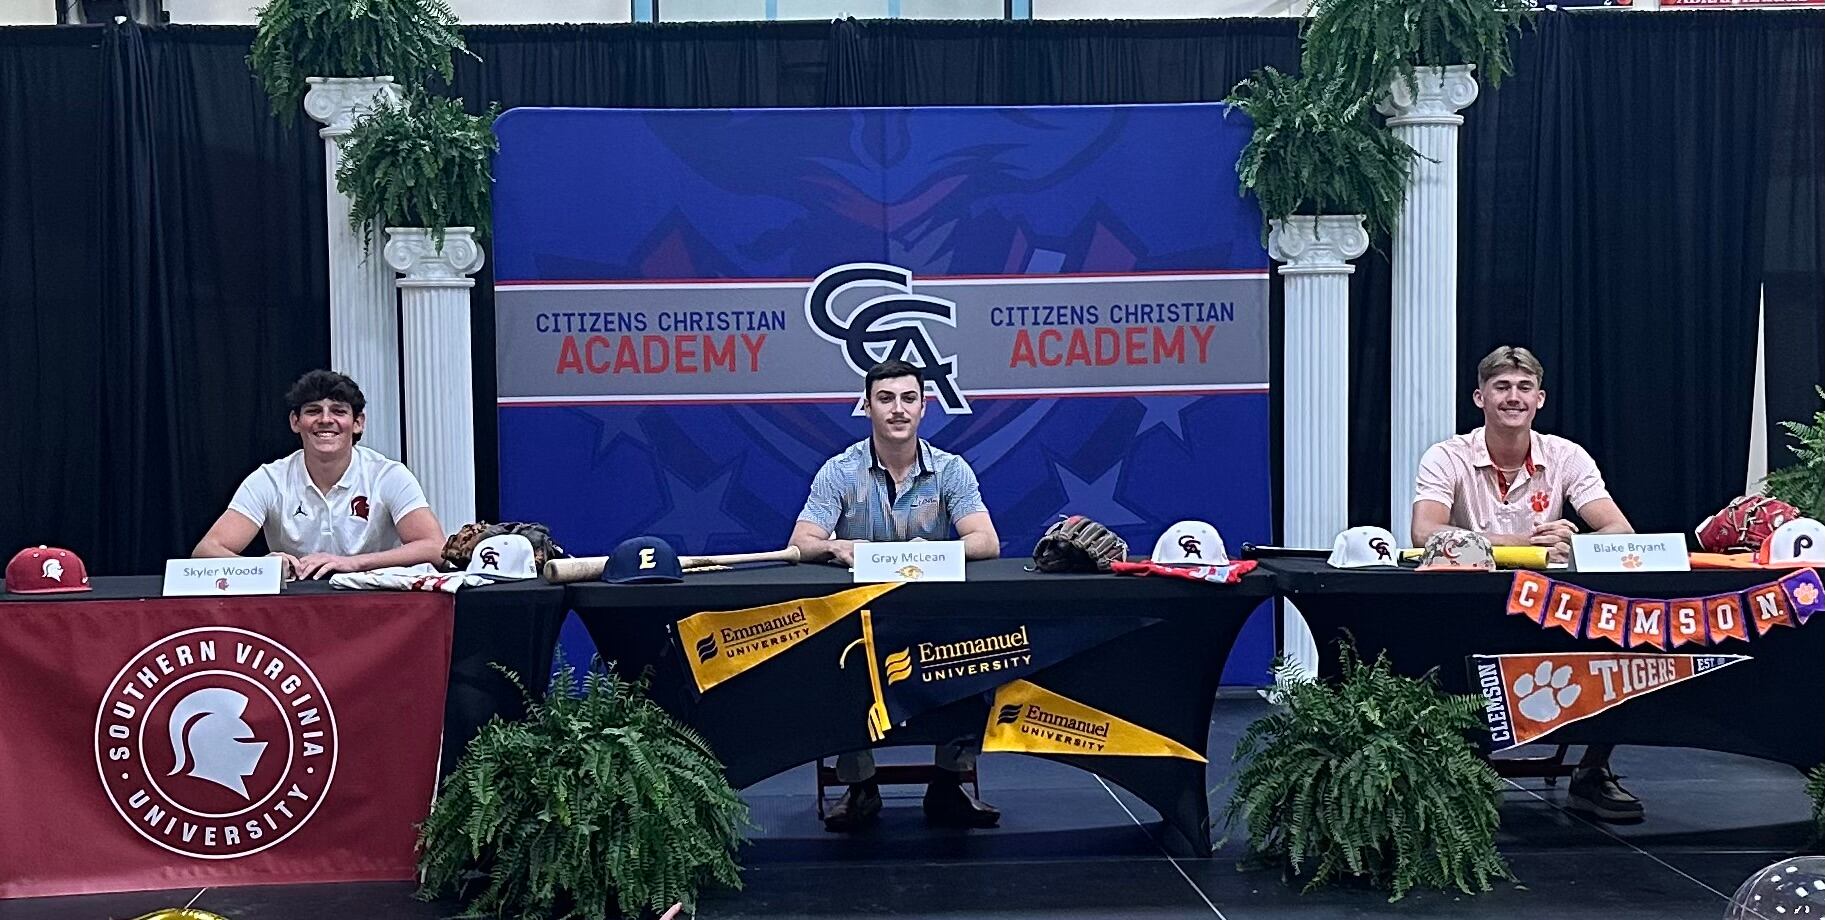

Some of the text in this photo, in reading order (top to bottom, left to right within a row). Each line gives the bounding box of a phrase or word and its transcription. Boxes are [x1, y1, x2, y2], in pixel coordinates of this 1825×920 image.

[536, 309, 786, 333] CITIZENS CHRISTIAN
[990, 301, 1235, 327] CITIZENS CHRISTIAN
[556, 334, 767, 375] ACADEMY
[1008, 325, 1215, 368] ACADEMY
[639, 548, 656, 570] E
[871, 553, 946, 565] Gray McLean
[1593, 543, 1666, 553] Blake Bryant
[1793, 534, 1813, 558] P
[183, 566, 264, 578] Skyler Woods
[720, 606, 807, 644] Emmanuel
[726, 627, 810, 658] UNIVERSITY
[918, 625, 1030, 663] Emmanuel
[922, 654, 1032, 682] UNIVERSITY
[1588, 658, 1676, 702] TIGERS
[109, 640, 324, 761] SOUTHERN VIRGINIA
[1478, 663, 1510, 742] CLEMSON
[1025, 704, 1110, 738] Emmanuel
[1021, 725, 1105, 752] UNIVERSITY
[128, 783, 310, 847] UNIVERSITY
